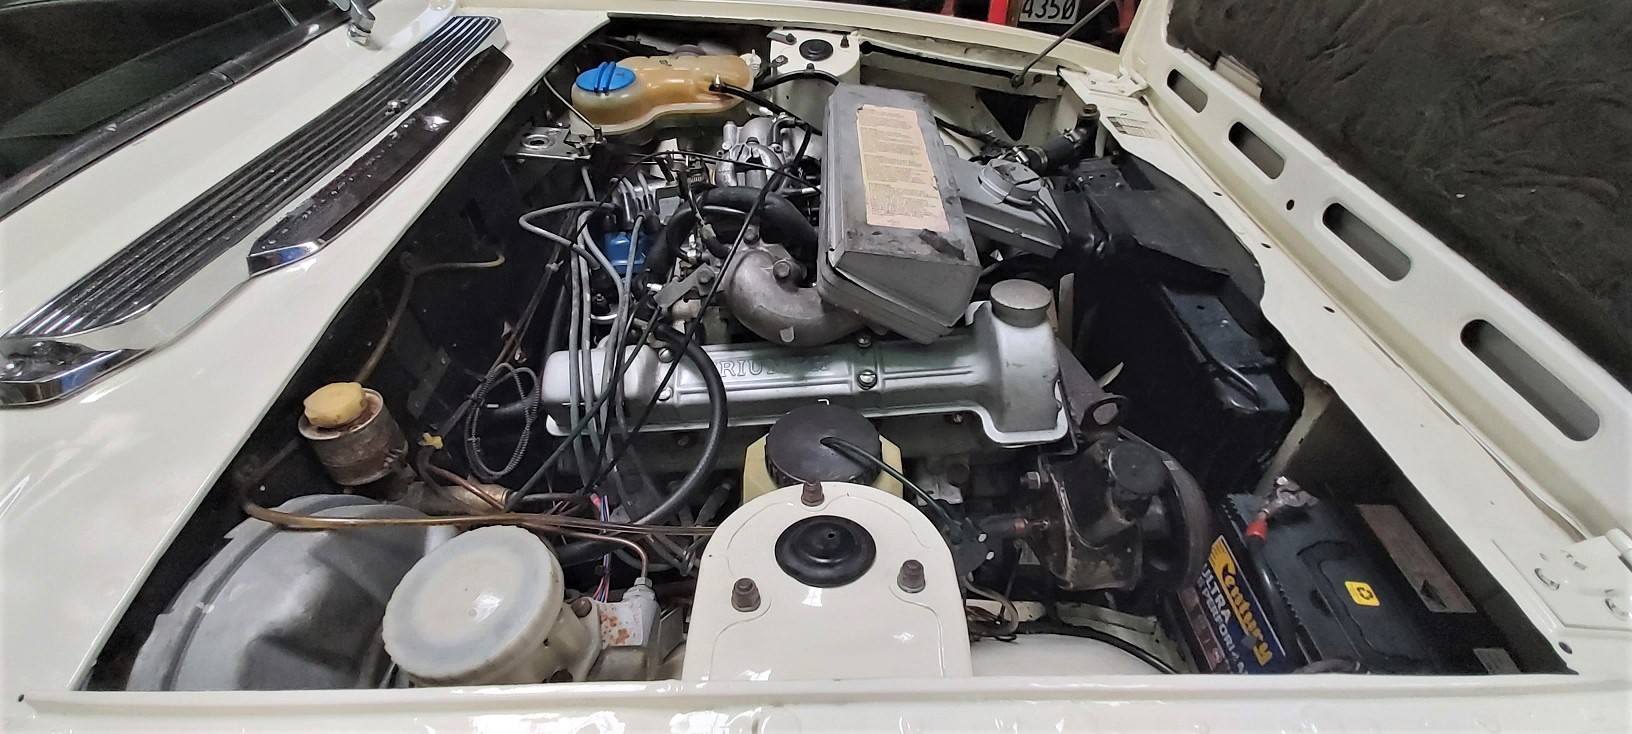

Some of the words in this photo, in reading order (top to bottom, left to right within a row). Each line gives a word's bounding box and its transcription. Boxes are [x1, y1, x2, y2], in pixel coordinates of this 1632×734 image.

[1022, 0, 1076, 20] 4350
[1202, 563, 1232, 626] ULTRA
[1208, 535, 1273, 666] Century
